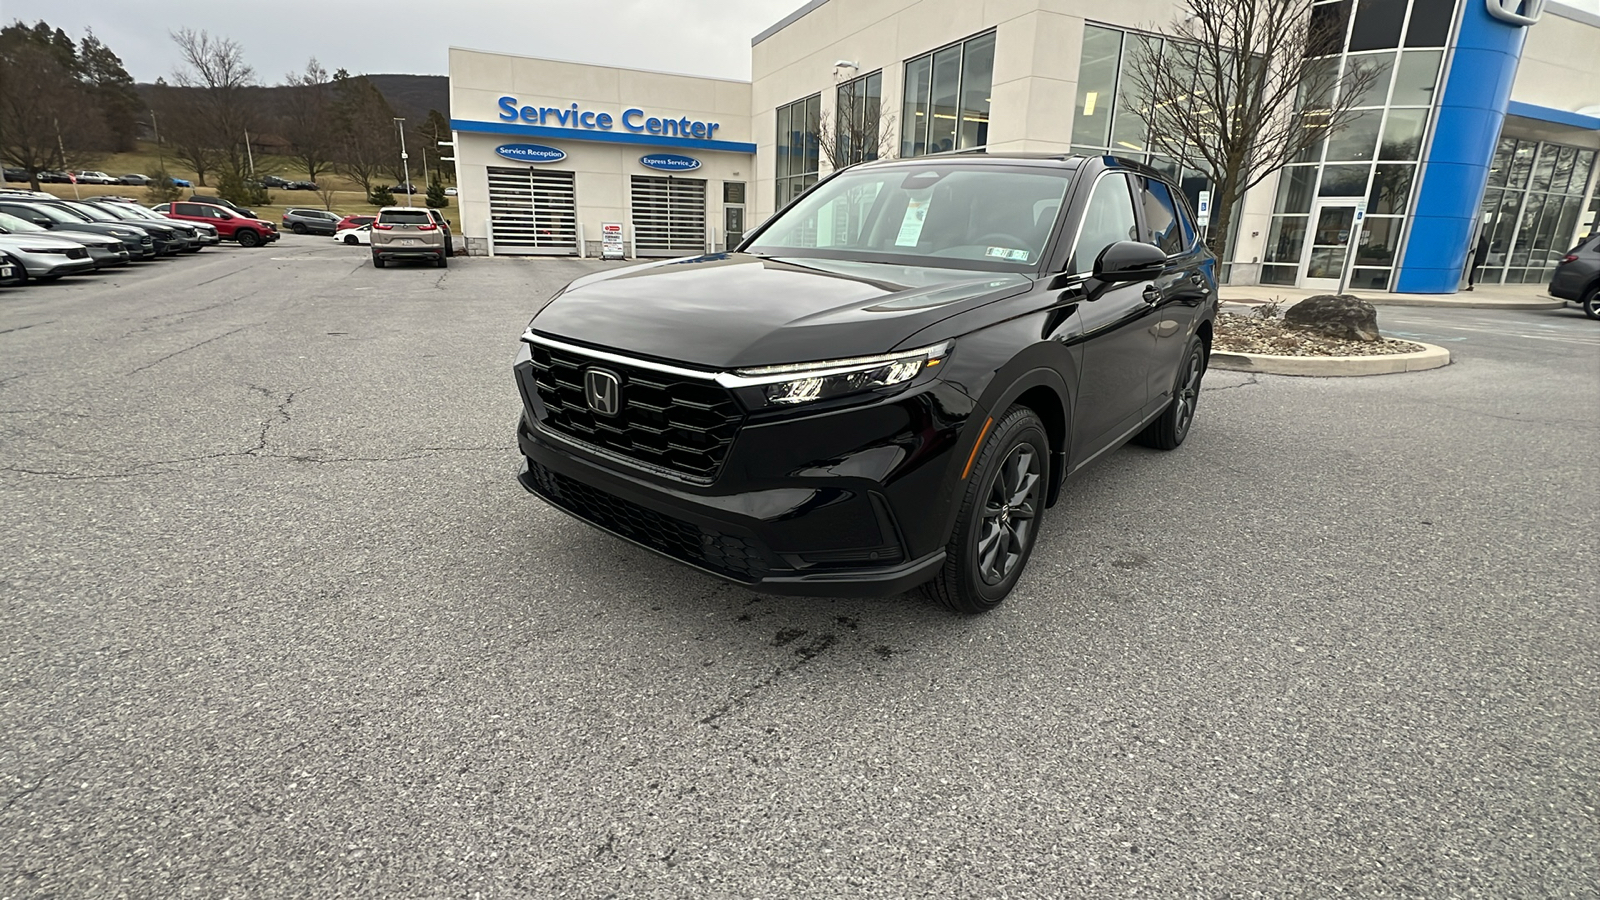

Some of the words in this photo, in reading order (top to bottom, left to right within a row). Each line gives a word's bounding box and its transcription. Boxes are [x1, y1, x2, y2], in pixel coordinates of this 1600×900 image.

[498, 96, 613, 130] Service
[622, 108, 720, 139] Center
[500, 147, 526, 155] Service
[527, 149, 562, 158] Reception
[643, 157, 667, 166] Express
